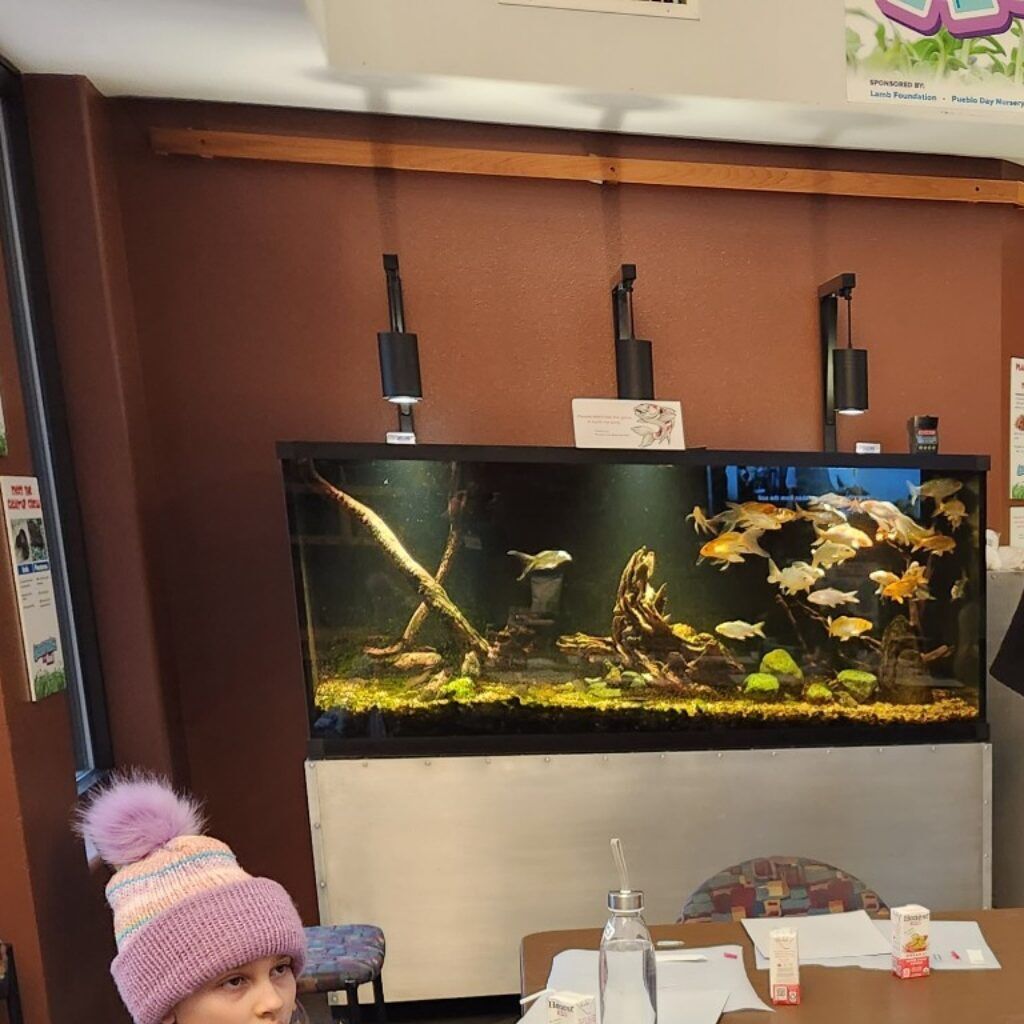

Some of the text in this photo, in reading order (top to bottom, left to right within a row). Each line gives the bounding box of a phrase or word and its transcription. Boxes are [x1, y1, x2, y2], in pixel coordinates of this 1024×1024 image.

[869, 79, 913, 89] SPONSORED
[870, 90, 937, 102] Lamb Foundation
[951, 95, 978, 104] Pueblo
[979, 97, 994, 107] Day
[995, 98, 1024, 109] Nursery
